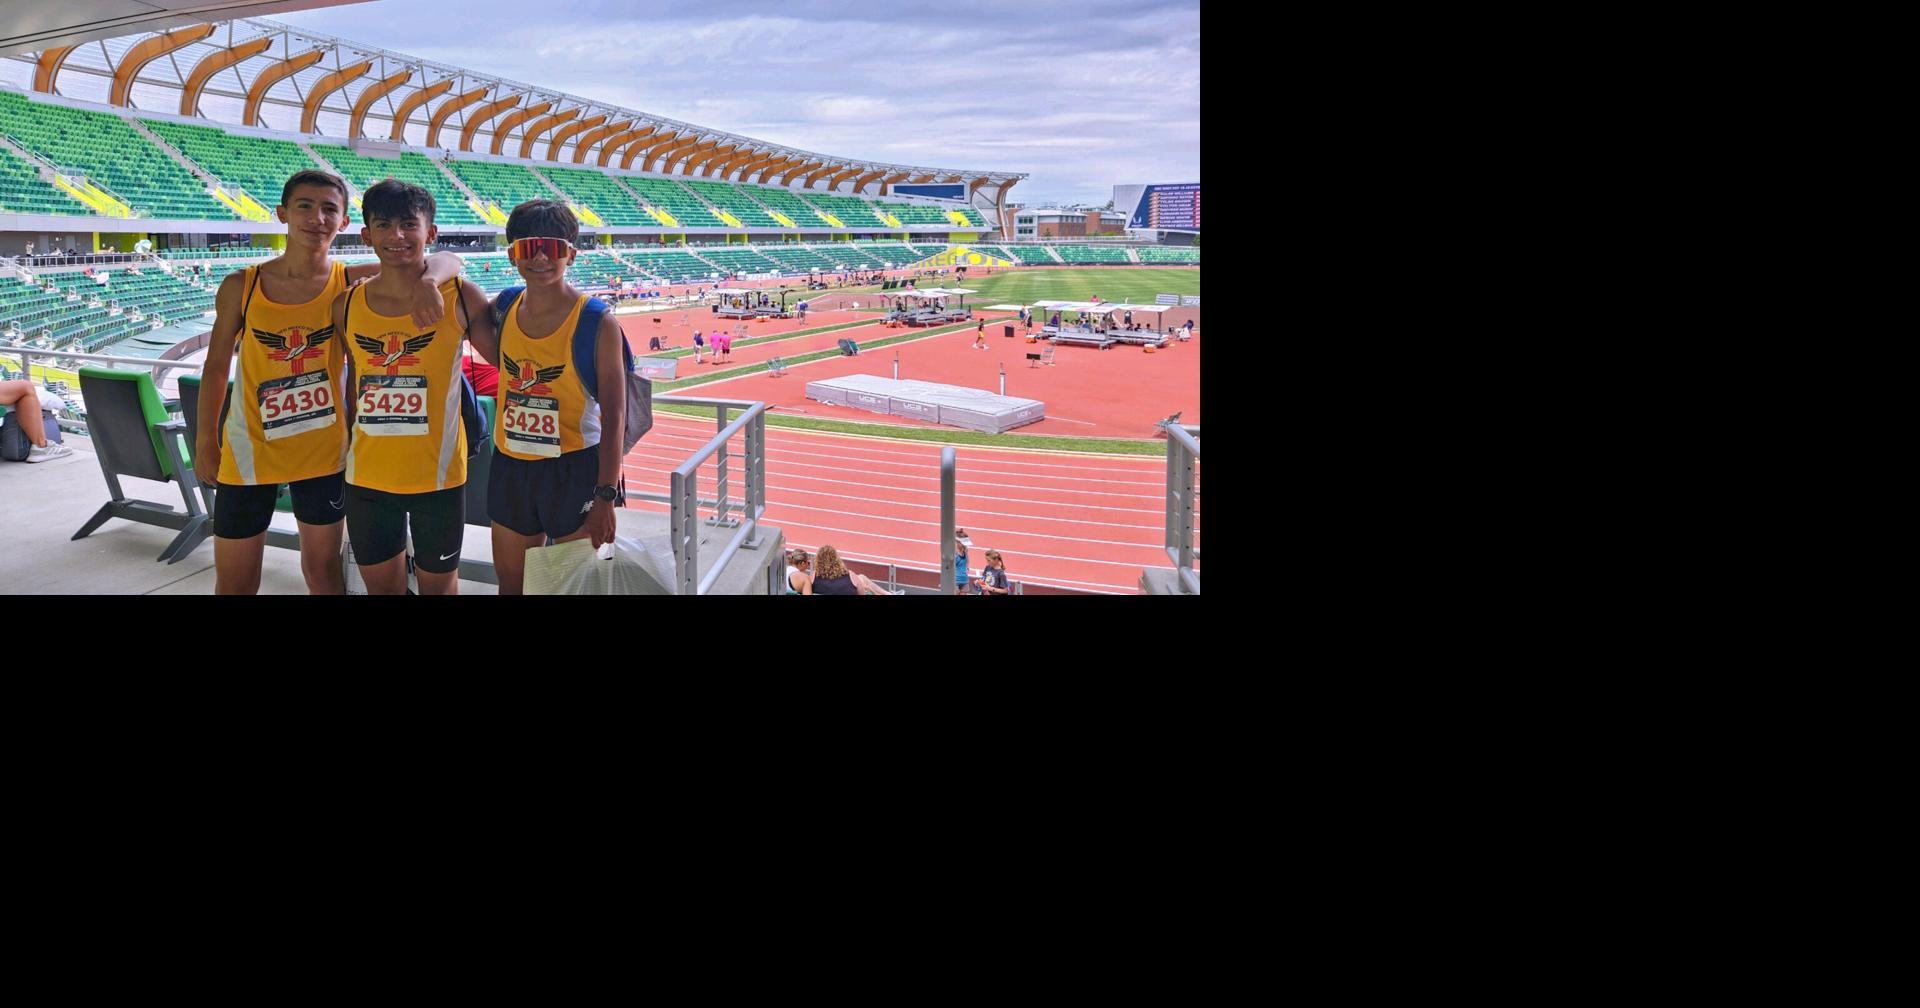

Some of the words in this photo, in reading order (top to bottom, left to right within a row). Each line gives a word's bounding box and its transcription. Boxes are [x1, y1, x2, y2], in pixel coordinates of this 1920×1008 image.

[265, 386, 329, 419] 5430
[362, 392, 423, 414] 5429
[505, 408, 556, 435] 5428
